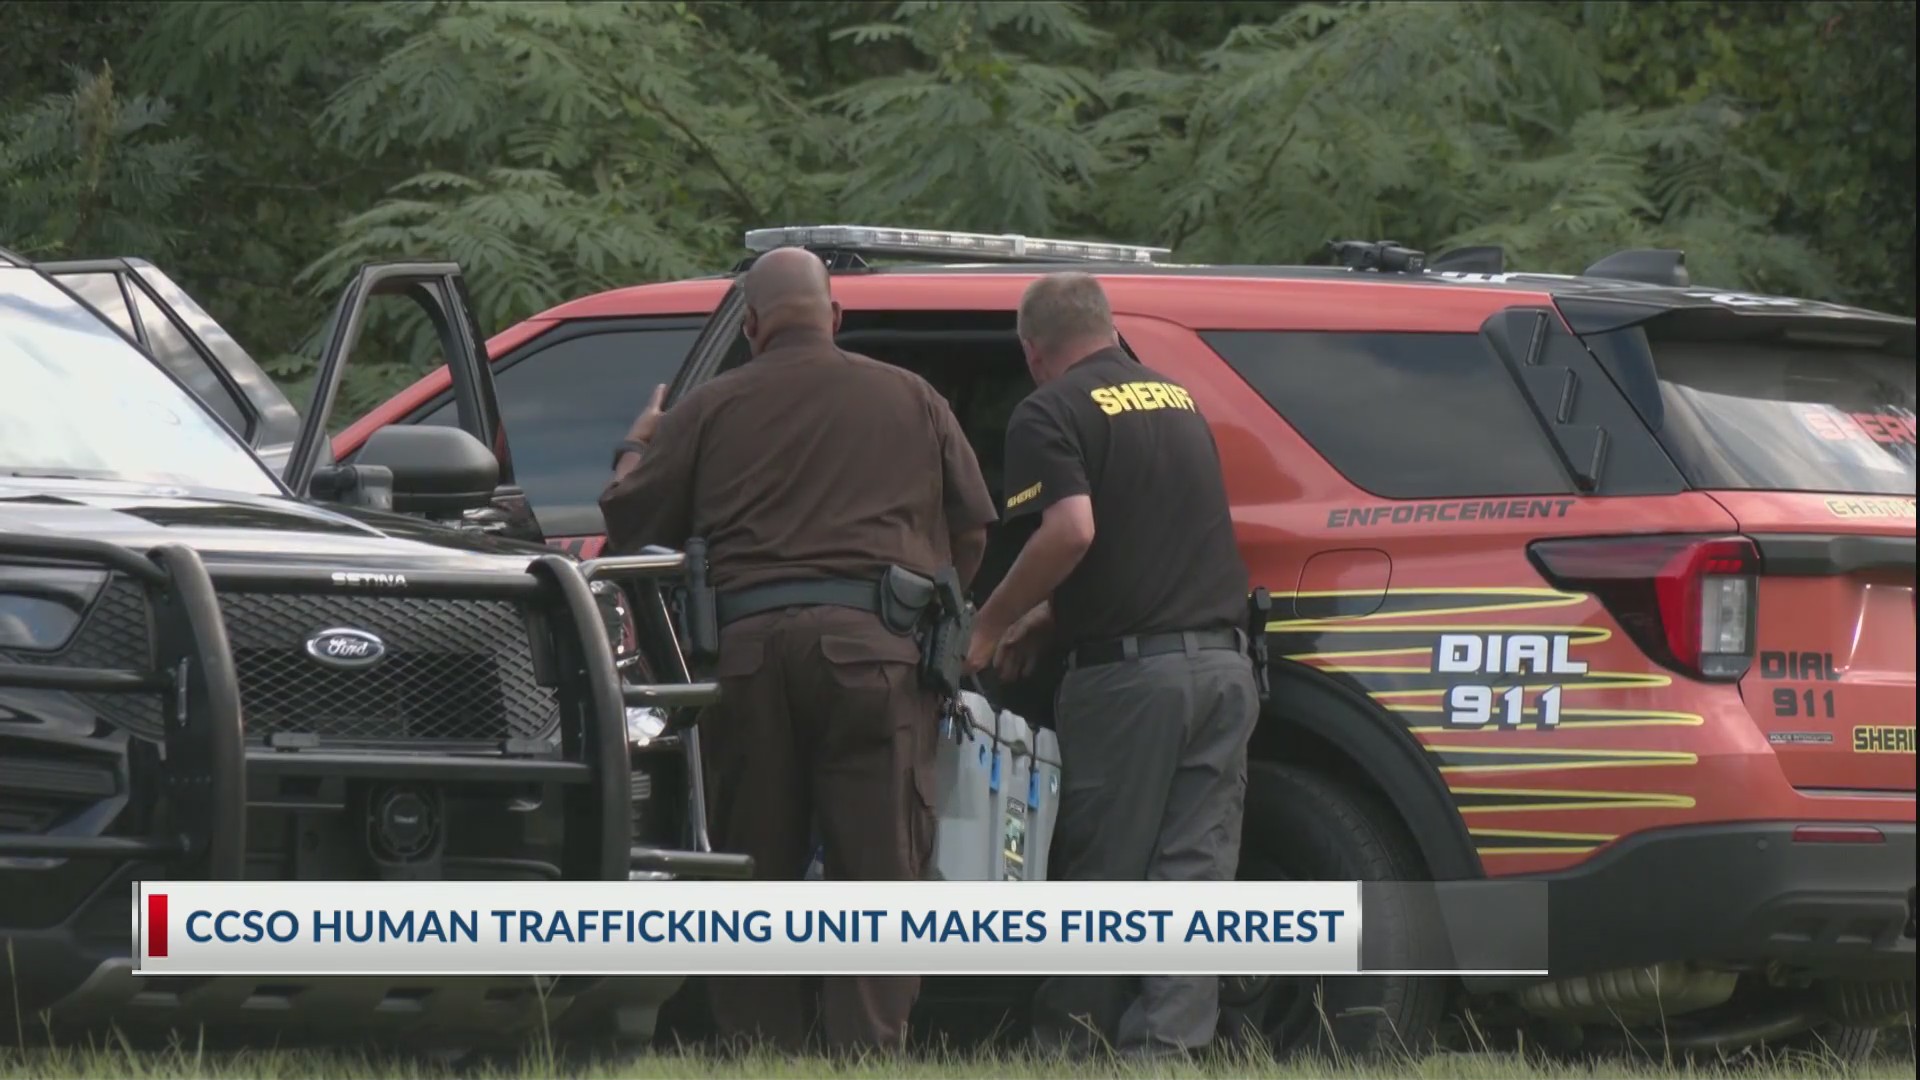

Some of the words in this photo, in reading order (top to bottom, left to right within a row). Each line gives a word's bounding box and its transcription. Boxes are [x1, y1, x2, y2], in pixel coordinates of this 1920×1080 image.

[1327, 499, 1576, 528] ENFORCEMENT
[331, 572, 408, 588] SETINA
[327, 638, 369, 656] Ford
[1438, 634, 1588, 674] DIAL
[1760, 651, 1842, 681] DIAL
[1449, 684, 1562, 726] 911
[1773, 688, 1835, 718] 911
[1853, 725, 1916, 753] SHERI
